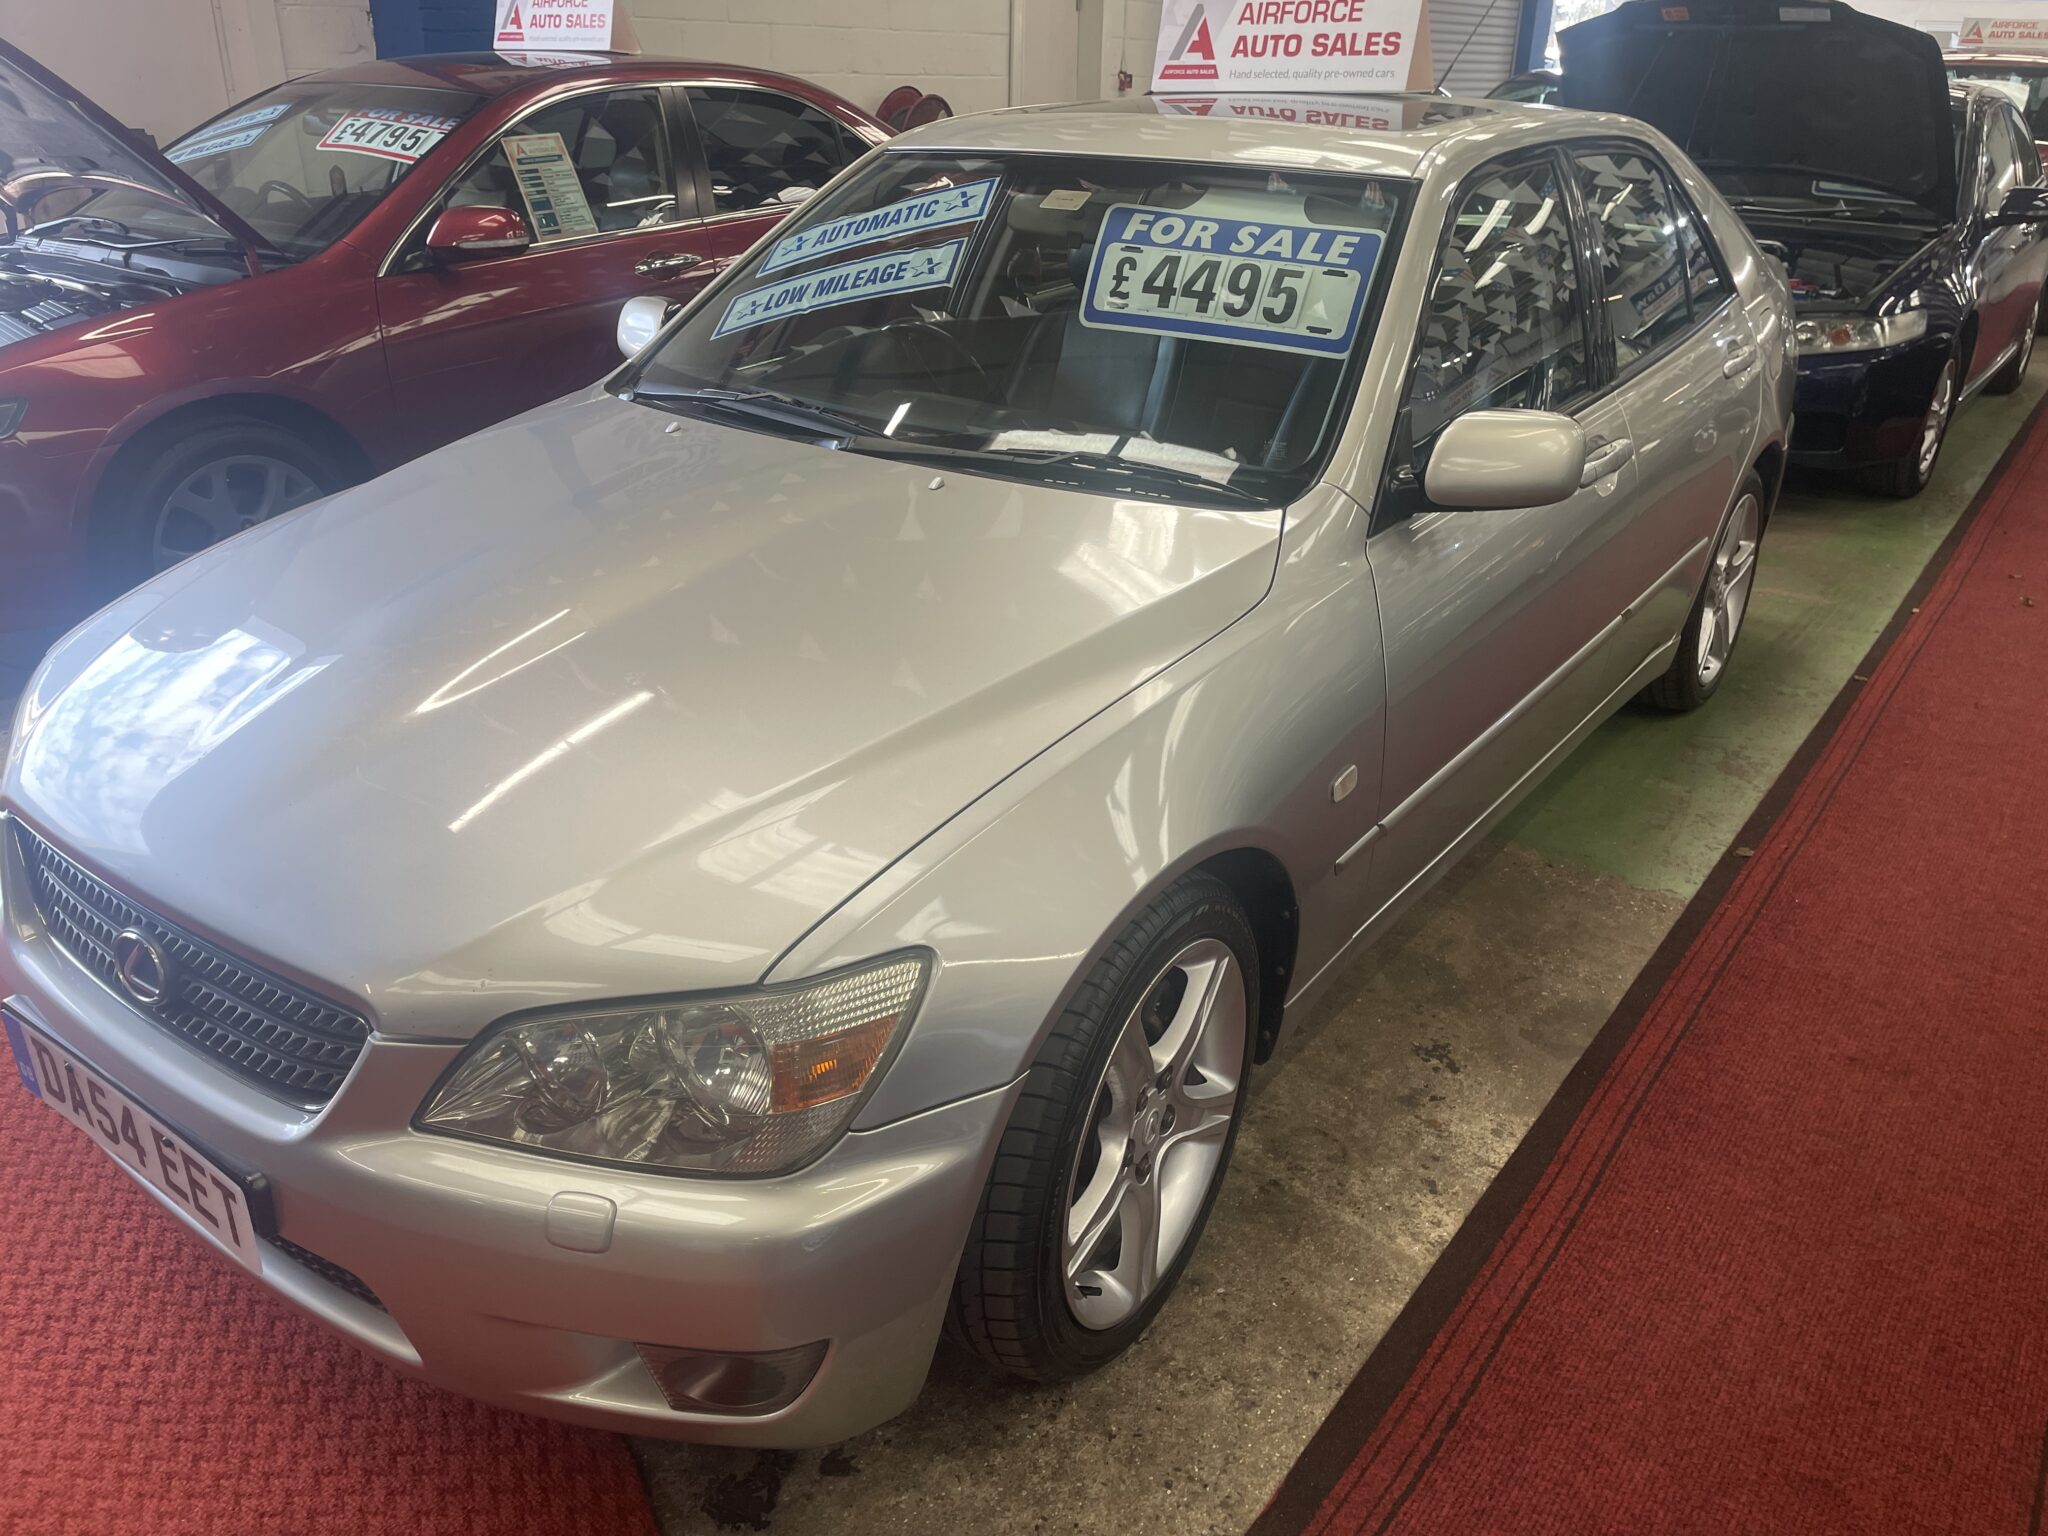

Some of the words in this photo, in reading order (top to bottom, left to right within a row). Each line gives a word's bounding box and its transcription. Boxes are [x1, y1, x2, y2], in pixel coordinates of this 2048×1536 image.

[532, 0, 588, 8] AIRFORCE
[1237, 0, 1365, 25] AIRFORCE
[530, 14, 562, 29] AUTO
[566, 14, 606, 29] SALES
[1991, 21, 2039, 29] AIRFORCE
[1230, 34, 1303, 58] AUTO
[1311, 32, 1402, 57] SALES
[1988, 31, 2015, 39] AUTO
[1229, 69, 1251, 79] Hand
[1252, 68, 1291, 80] selected,
[1292, 68, 1322, 81] quality
[1324, 68, 1374, 81] pre-owned
[1375, 69, 1395, 79] cars
[401, 112, 461, 129] SALE
[331, 121, 428, 152] £4795
[811, 200, 940, 248] AUTOMATIC
[1121, 212, 1219, 250] FOR
[1229, 226, 1361, 266] SALE
[762, 283, 811, 312] LOW
[812, 260, 910, 299] MILEAGE
[1108, 254, 1305, 325] £4495
[30, 1034, 147, 1169] DA54
[150, 1124, 242, 1248] EET
